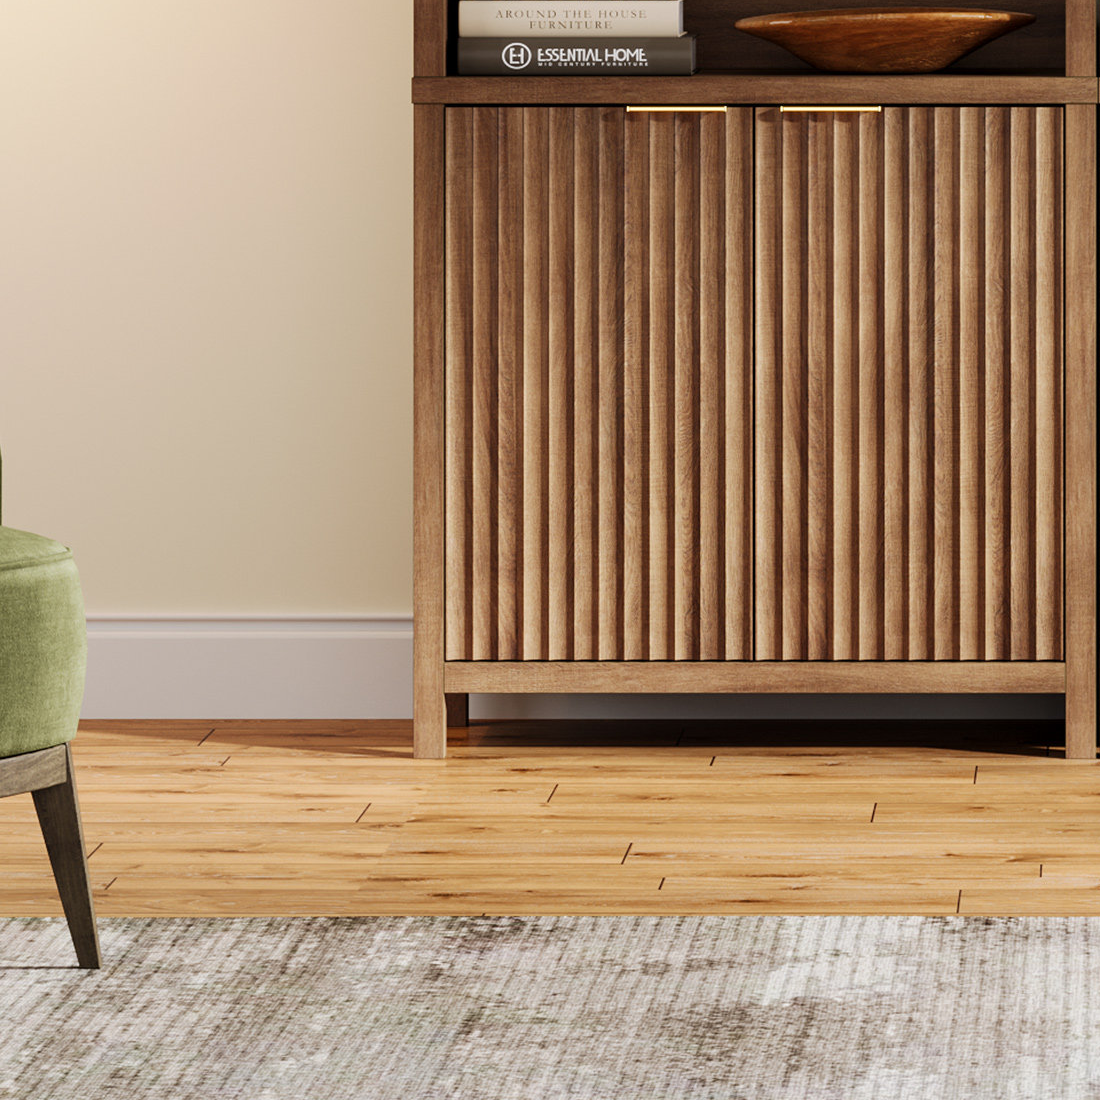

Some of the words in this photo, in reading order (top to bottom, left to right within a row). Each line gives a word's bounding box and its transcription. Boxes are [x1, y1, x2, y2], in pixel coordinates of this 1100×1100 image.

[495, 9, 557, 19] AROUND
[563, 9, 592, 19] THE
[599, 9, 647, 19] HOUSE
[529, 20, 613, 30] FURNITURE
[537, 48, 602, 62] ESSENTIAL
[604, 48, 647, 62] HOME
